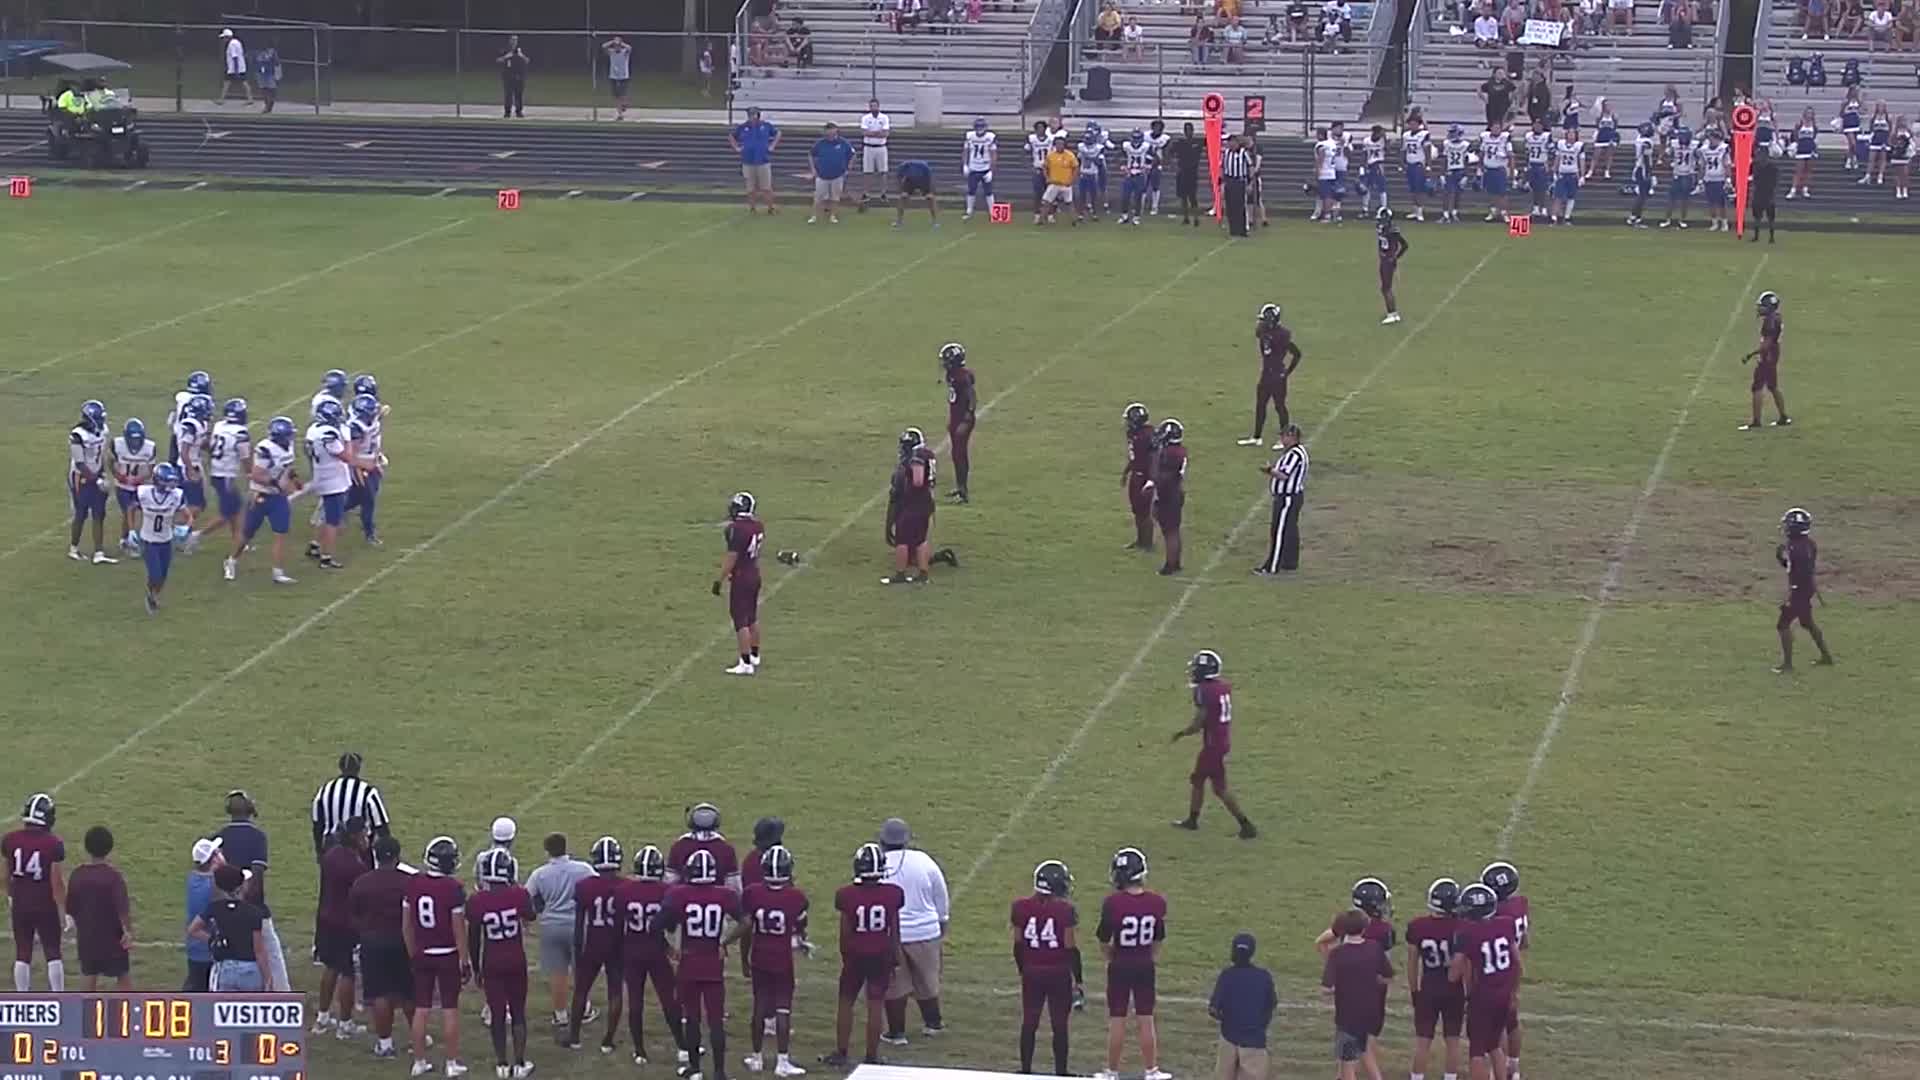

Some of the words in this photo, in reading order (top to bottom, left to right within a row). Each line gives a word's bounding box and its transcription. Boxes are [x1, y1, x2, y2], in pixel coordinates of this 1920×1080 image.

[1246, 98, 1263, 118] 2
[992, 205, 1010, 221] 30
[1512, 218, 1528, 233] 40
[154, 514, 164, 533] 0
[12, 847, 44, 881] 14
[417, 895, 435, 929] 8
[483, 908, 519, 940] 25
[684, 903, 723, 937] 20
[755, 908, 786, 935] 13
[855, 904, 887, 933] 18
[1023, 916, 1059, 949] 44
[1119, 915, 1156, 947] 28
[1420, 938, 1450, 968] 31
[1480, 936, 1511, 975] 16
